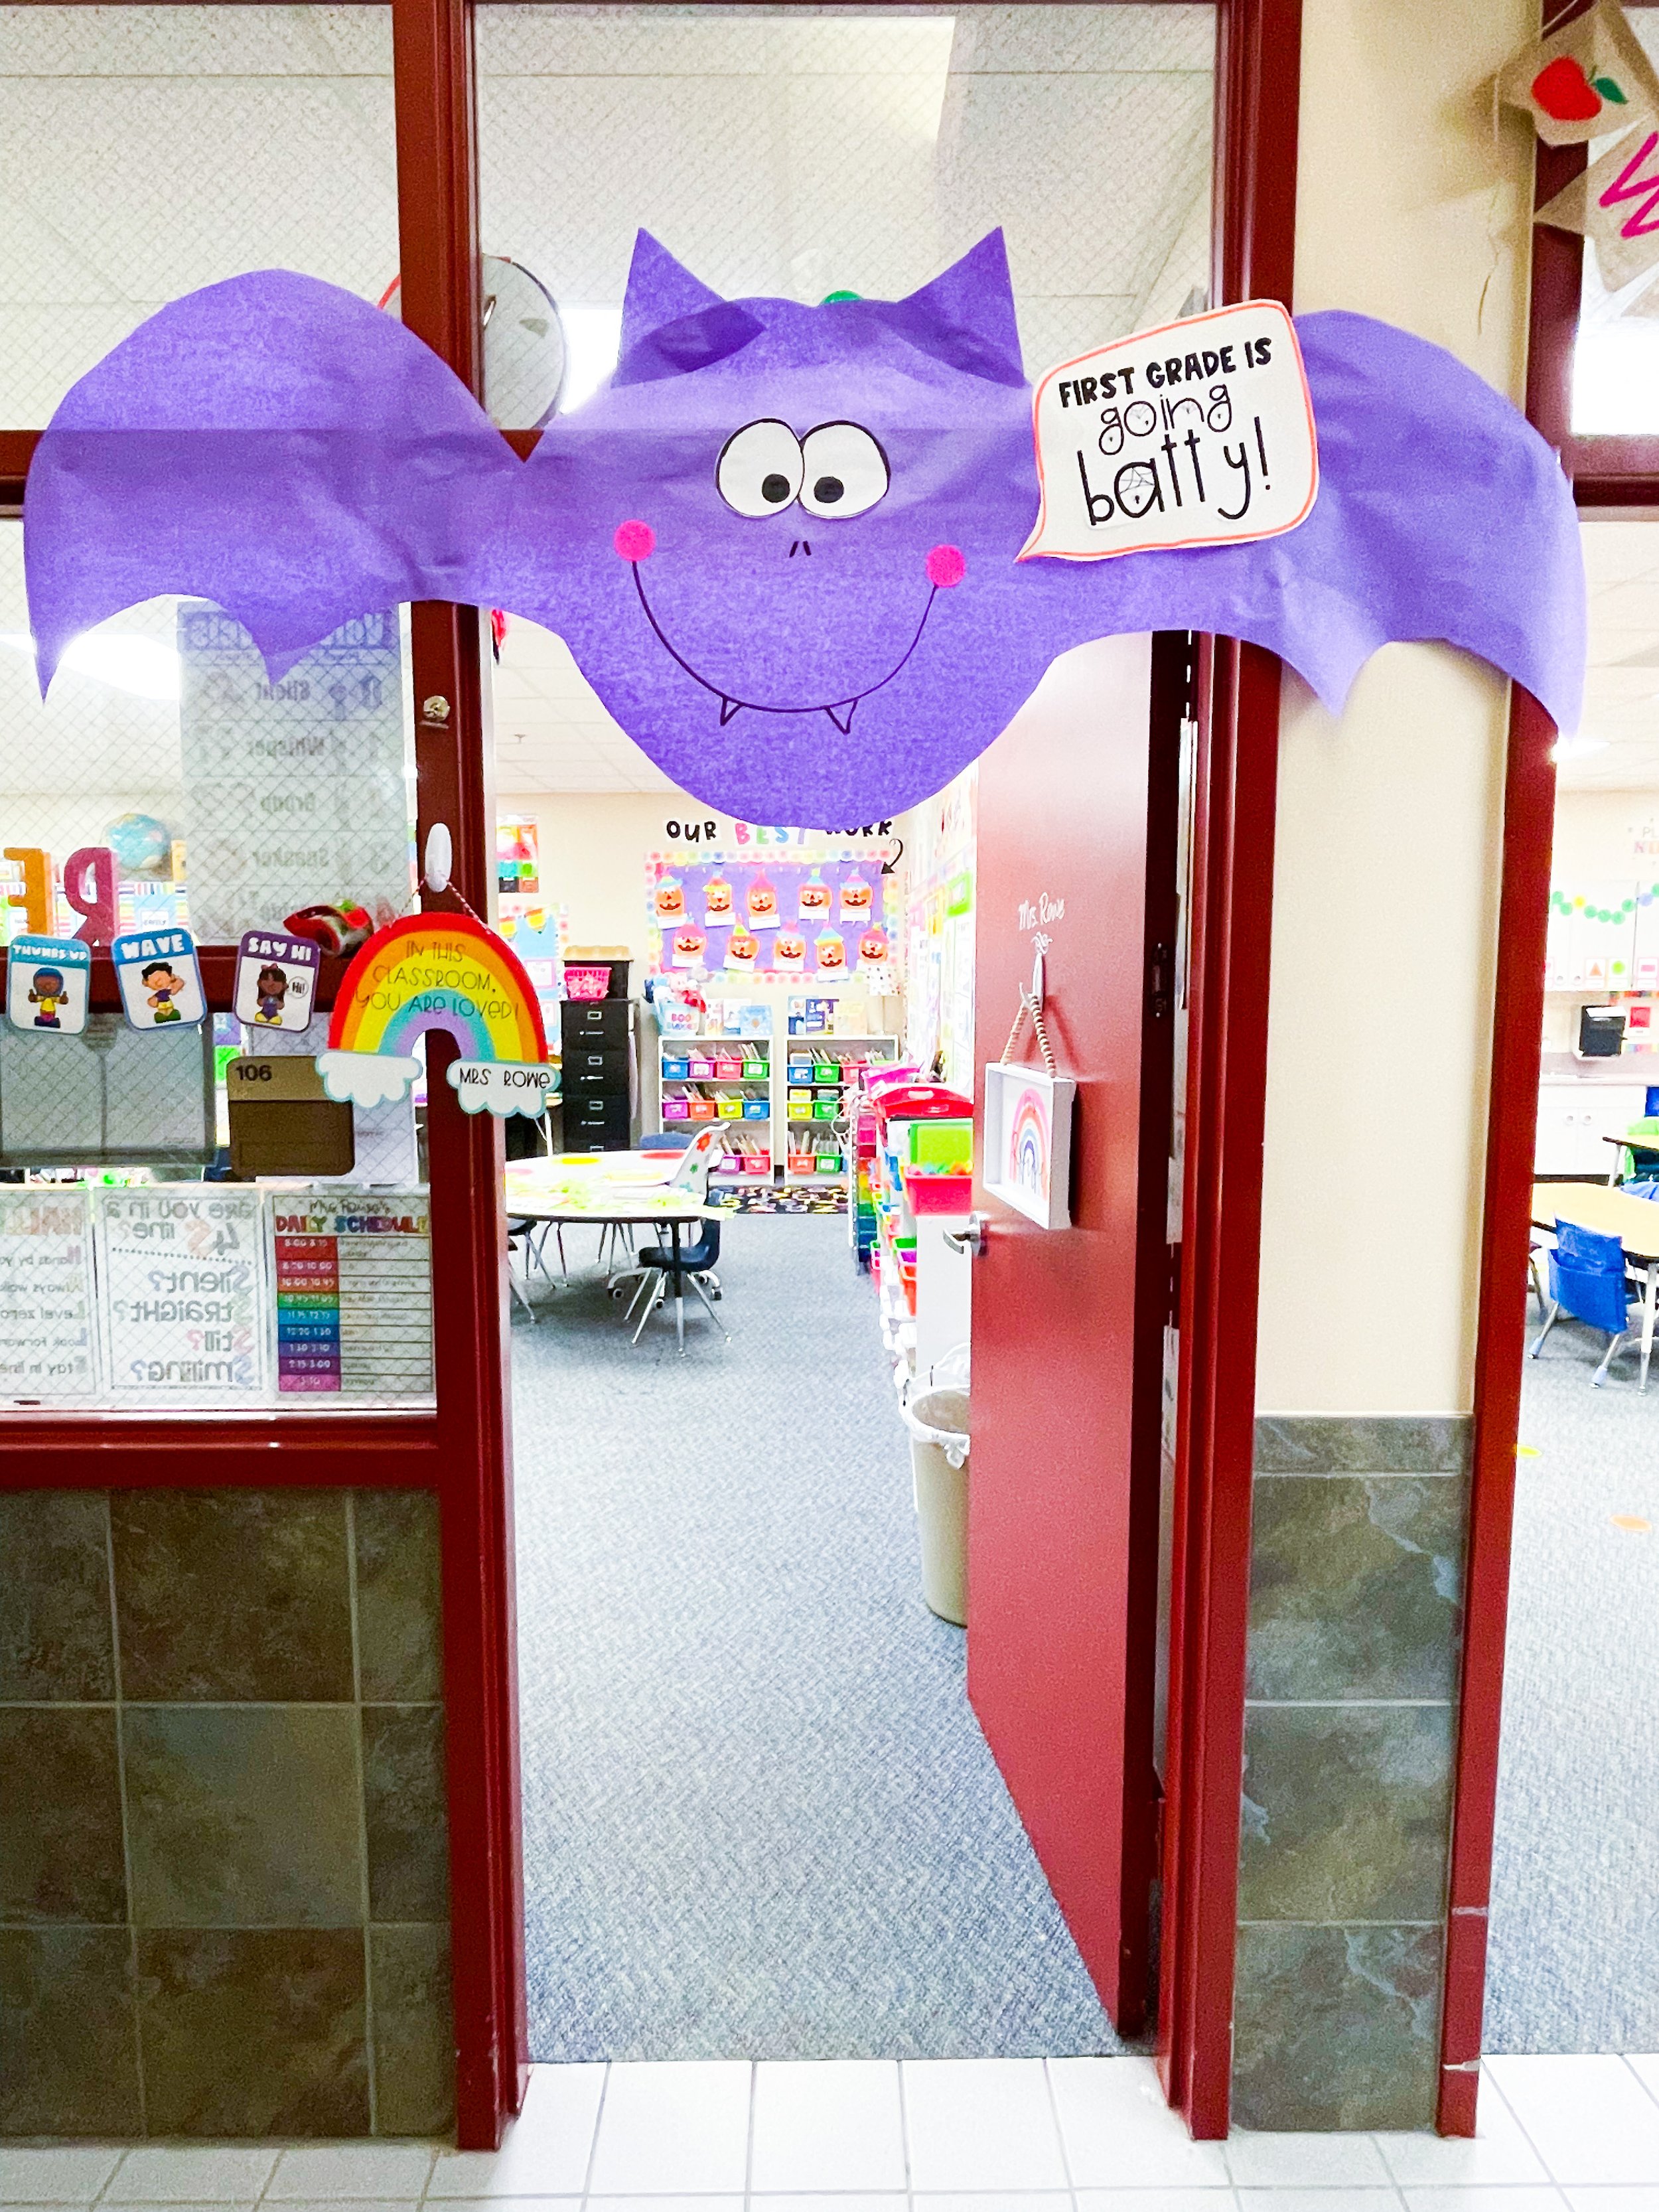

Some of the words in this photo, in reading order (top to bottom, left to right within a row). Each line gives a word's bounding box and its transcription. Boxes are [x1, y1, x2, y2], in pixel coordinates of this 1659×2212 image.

[1058, 367, 1134, 407] FIRST
[1146, 345, 1236, 388] GRADE
[1244, 337, 1272, 369] IS
[1098, 384, 1233, 455] going
[1077, 416, 1271, 526] batty!
[666, 820, 716, 842] OUR
[1039, 892, 1065, 924] Rowe
[13, 945, 67, 960] THUMBS
[70, 950, 88, 960] UP
[121, 934, 184, 960] WAVE
[248, 937, 287, 957] SAY
[290, 945, 311, 962] HI
[405, 940, 423, 959] IN
[432, 942, 466, 962] THIS
[354, 990, 402, 1010] YOU
[236, 1065, 273, 1081] 106
[460, 1068, 492, 1086] MRS
[275, 1215, 327, 1233] DAILY
[334, 1215, 429, 1234] SCHEDULE
